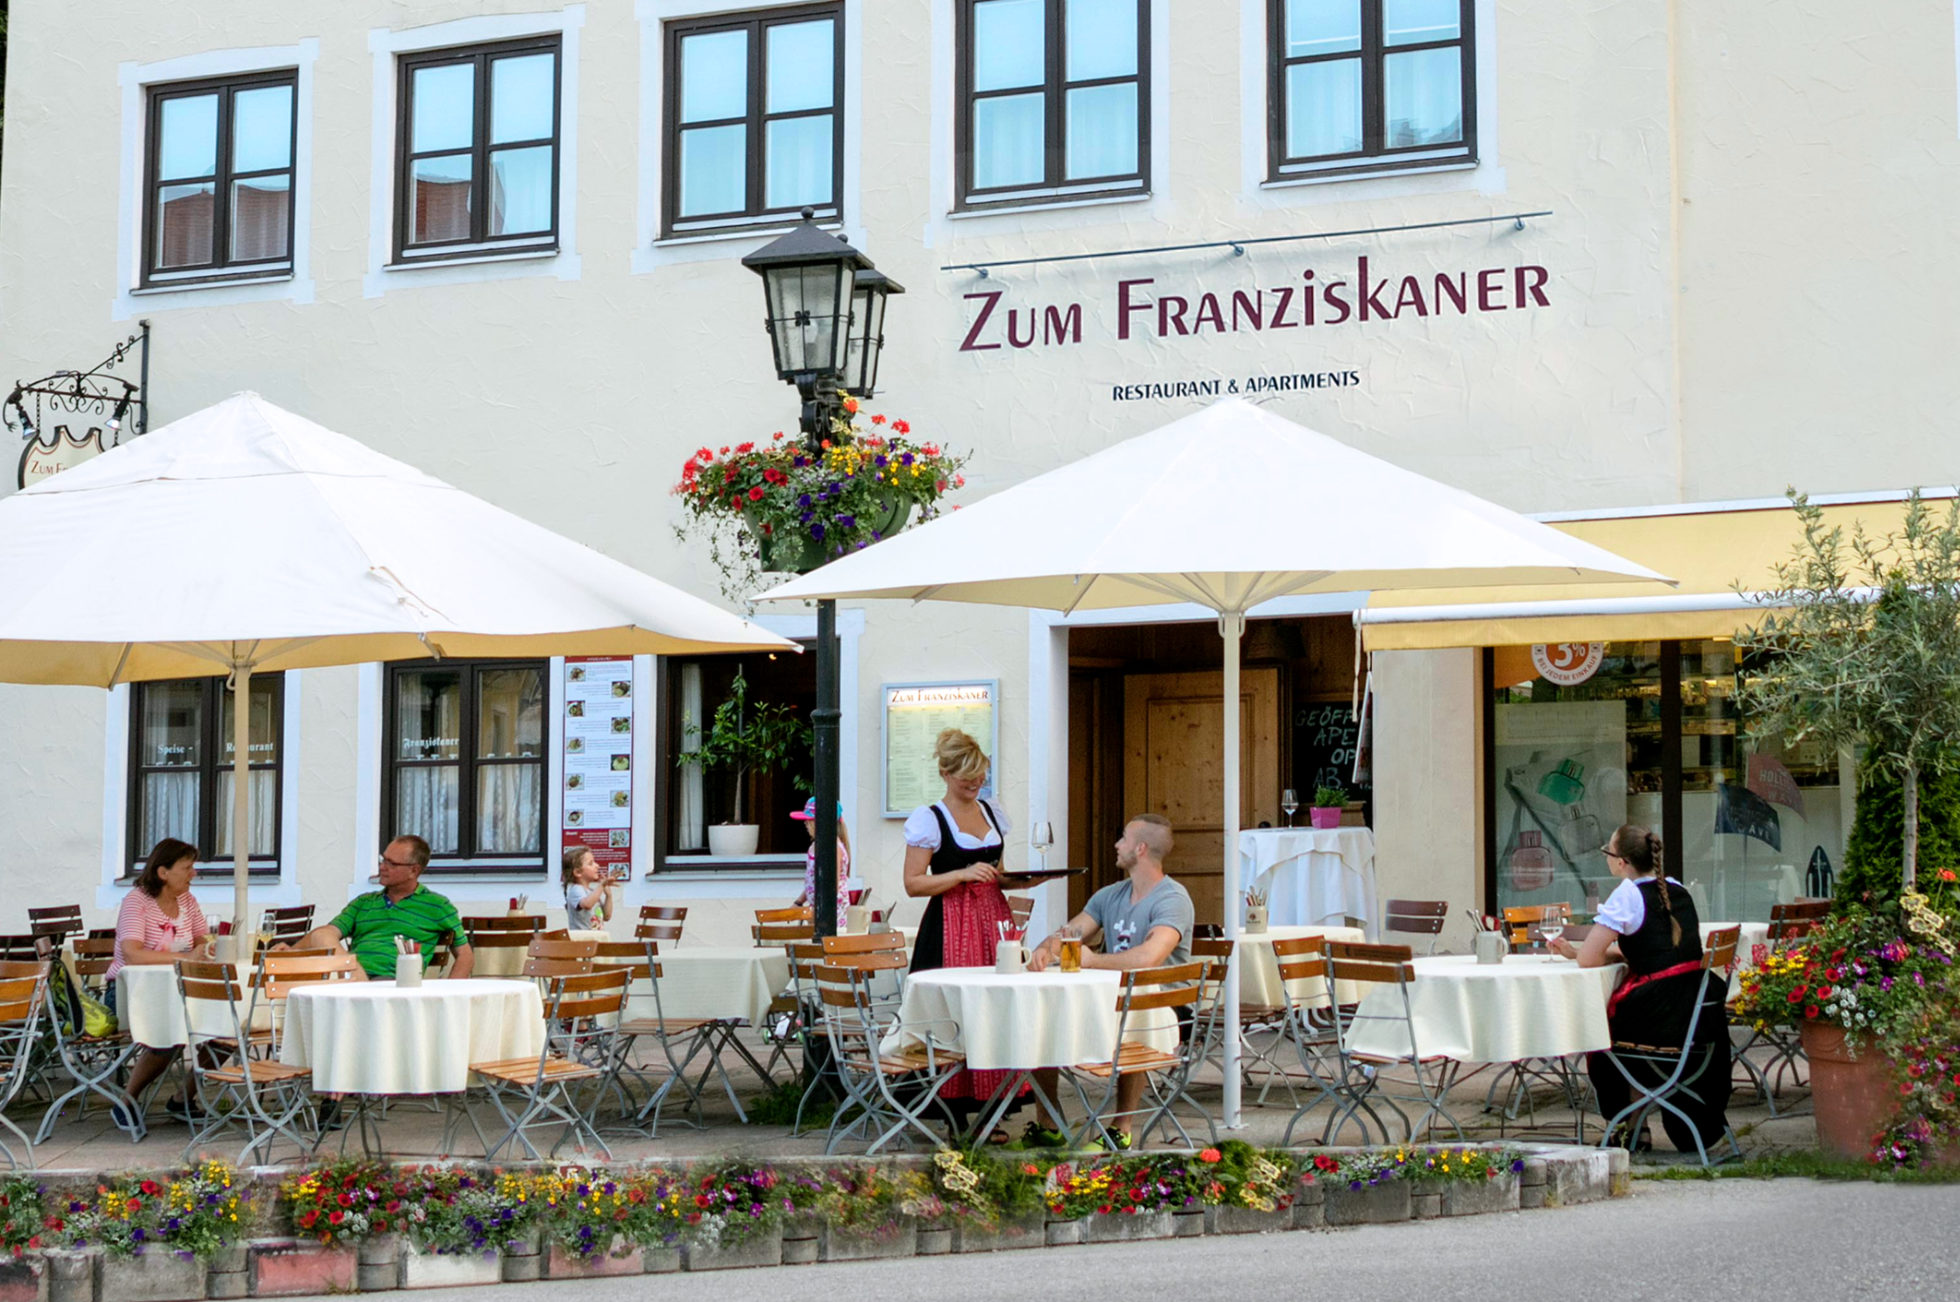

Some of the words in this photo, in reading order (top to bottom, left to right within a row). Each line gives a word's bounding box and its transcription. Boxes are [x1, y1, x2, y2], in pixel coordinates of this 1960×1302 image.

[959, 291, 1082, 352] ZUM
[1112, 379, 1221, 401] RESTAURANT
[1227, 378, 1239, 394] &
[1245, 370, 1360, 393] APARTMENTS
[31, 460, 54, 475] ZUM
[1537, 657, 1548, 670] BEI
[1545, 669, 1570, 681] JEDEM
[1571, 654, 1597, 680] EINKAUF
[892, 689, 914, 703] ZUM
[1295, 706, 1361, 726] GEÖFF
[226, 742, 273, 752] Reurant
